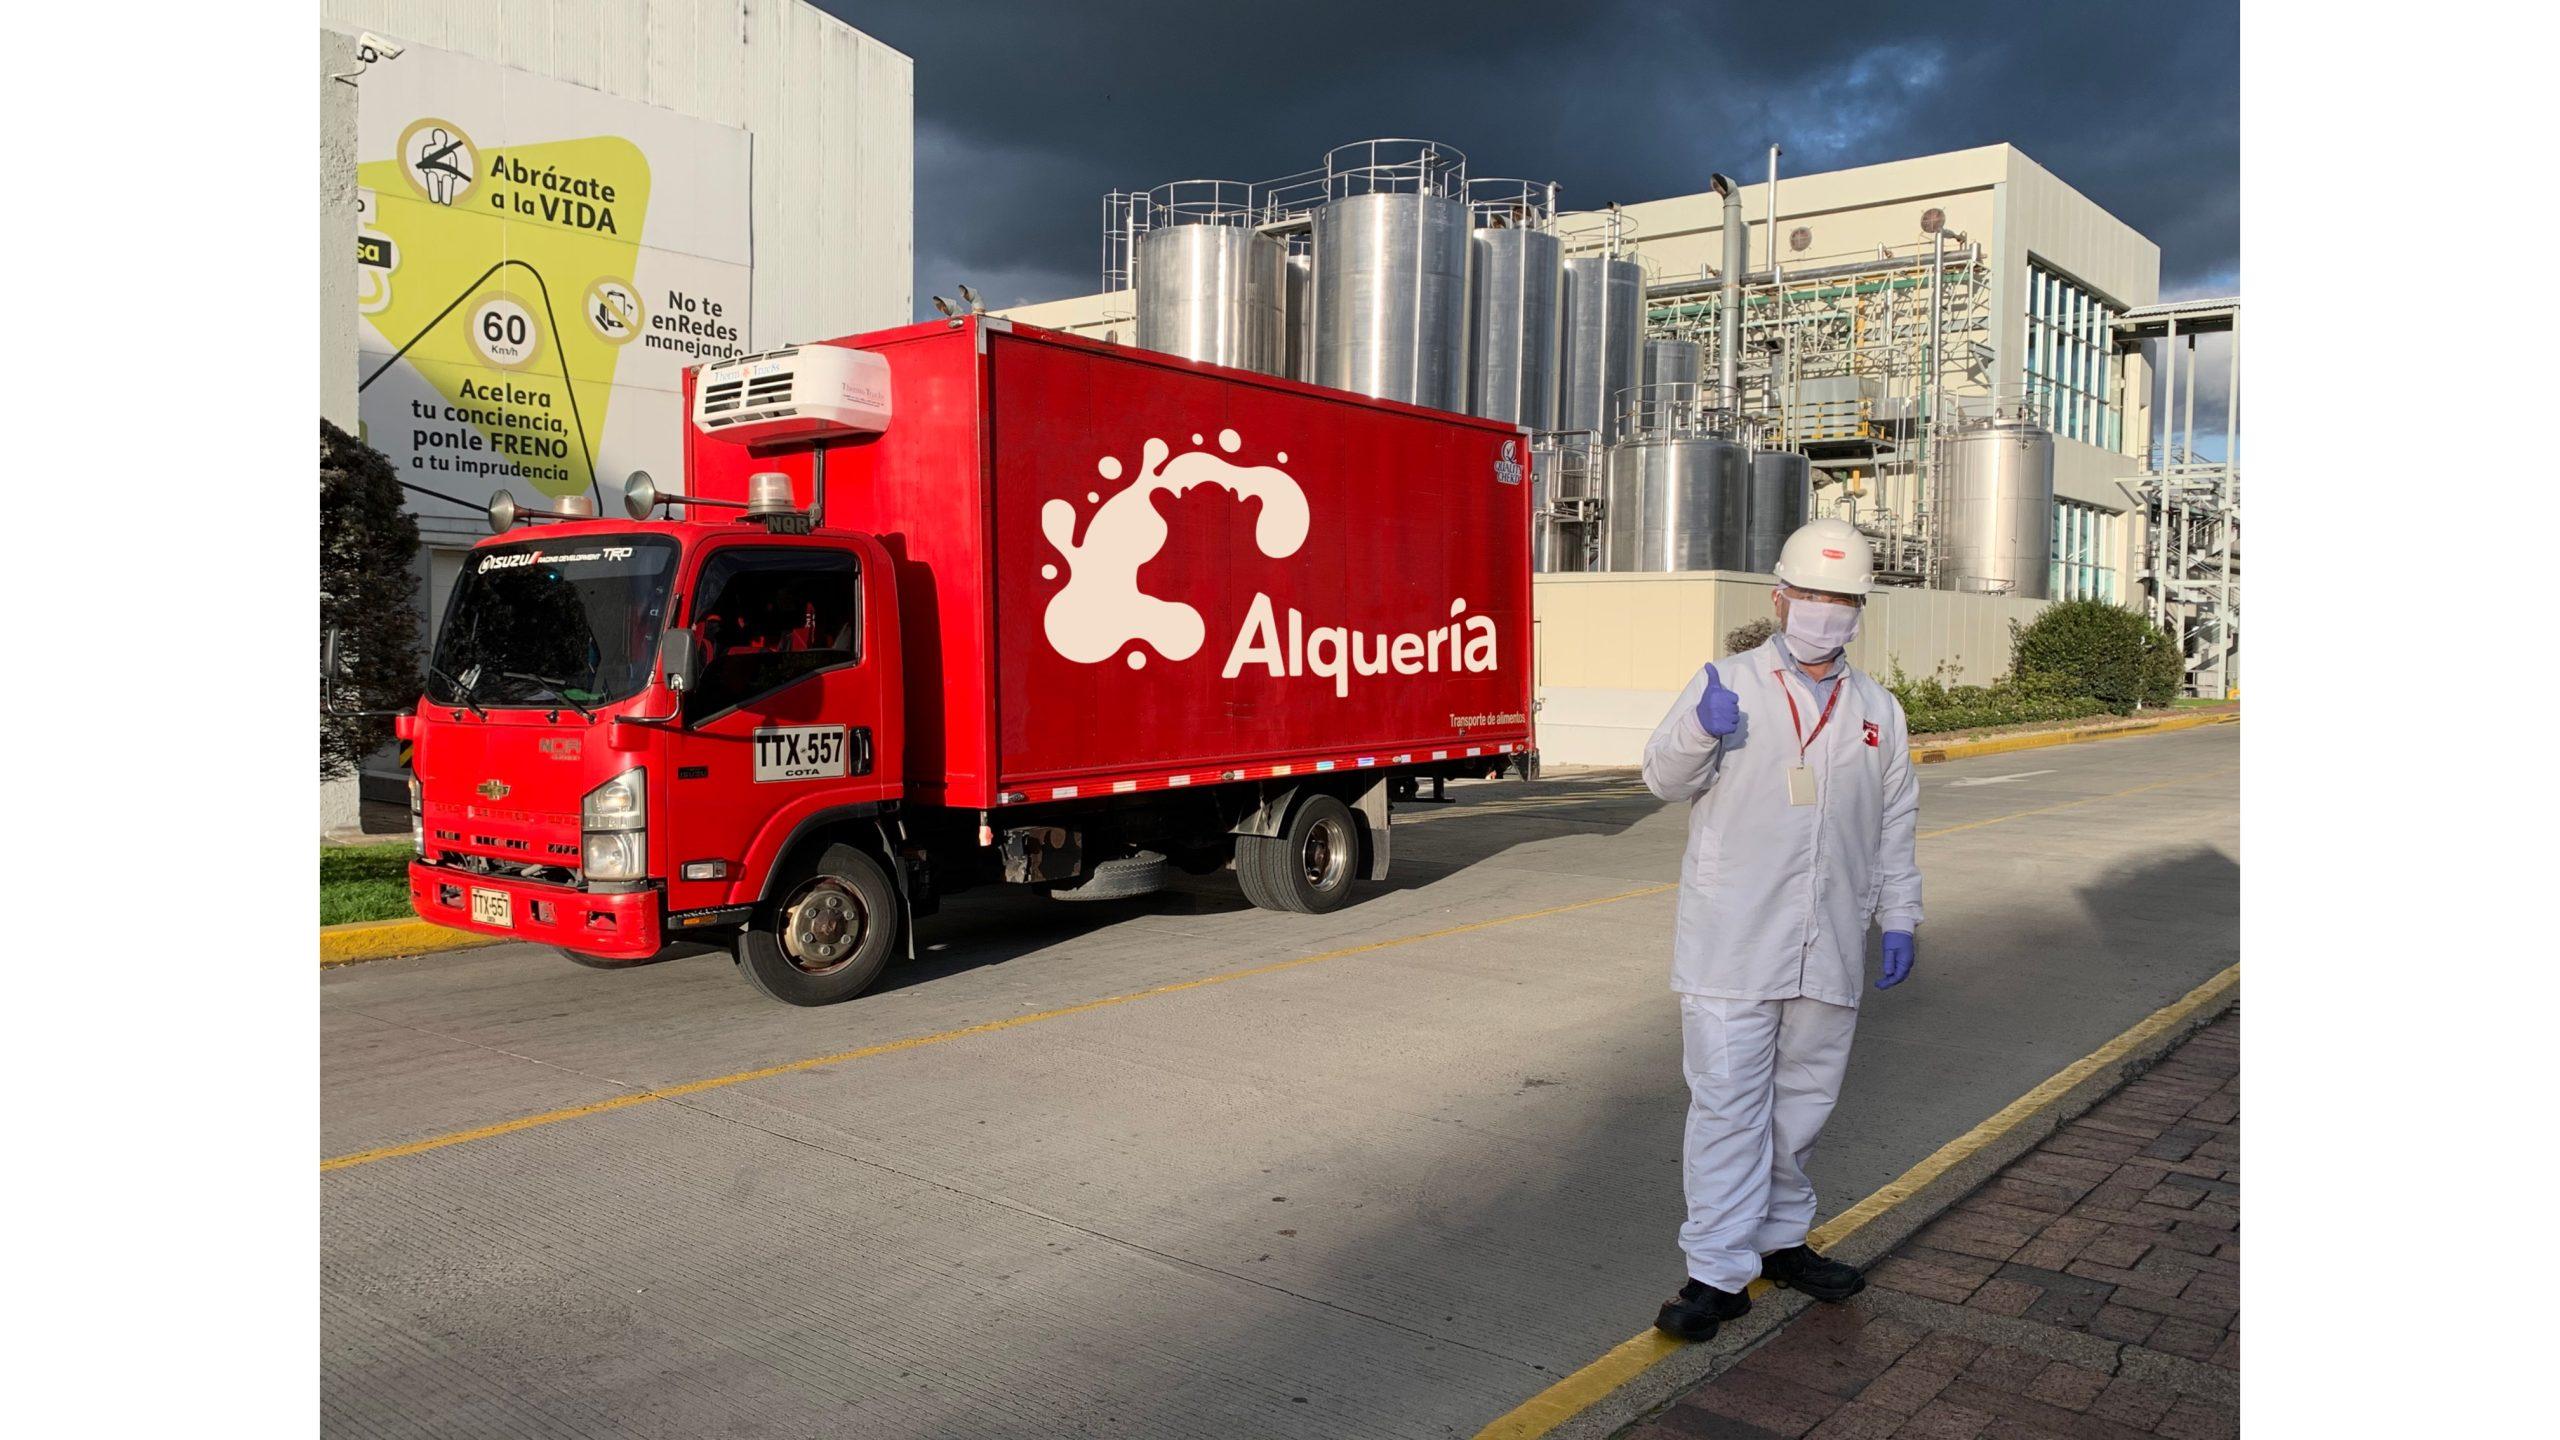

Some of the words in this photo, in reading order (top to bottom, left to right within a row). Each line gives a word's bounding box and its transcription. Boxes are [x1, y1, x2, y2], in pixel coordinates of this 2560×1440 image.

[490, 155, 615, 203] Abrázate
[491, 193, 504, 209] a
[514, 192, 535, 216] la
[540, 193, 617, 235] VIDA
[669, 290, 696, 312] No
[702, 298, 722, 317] te
[483, 311, 526, 345] 60
[652, 315, 737, 341] enRedes
[491, 345, 518, 357] Km/h
[460, 379, 551, 408] Acelera
[412, 400, 436, 419] tu
[444, 407, 568, 437] conciencia,
[413, 429, 483, 451] ponle
[491, 433, 568, 459] FRENO
[412, 456, 423, 469] a
[429, 455, 449, 470] tu
[456, 456, 568, 481] imprudencia
[769, 515, 809, 534] NQR
[491, 554, 530, 569] ISUZU
[1221, 592, 1498, 698] Alquería
[1449, 713, 1486, 730] Transporte
[1487, 712, 1496, 725] de
[1496, 711, 1525, 725] alimentos
[785, 768, 820, 777] COTA
